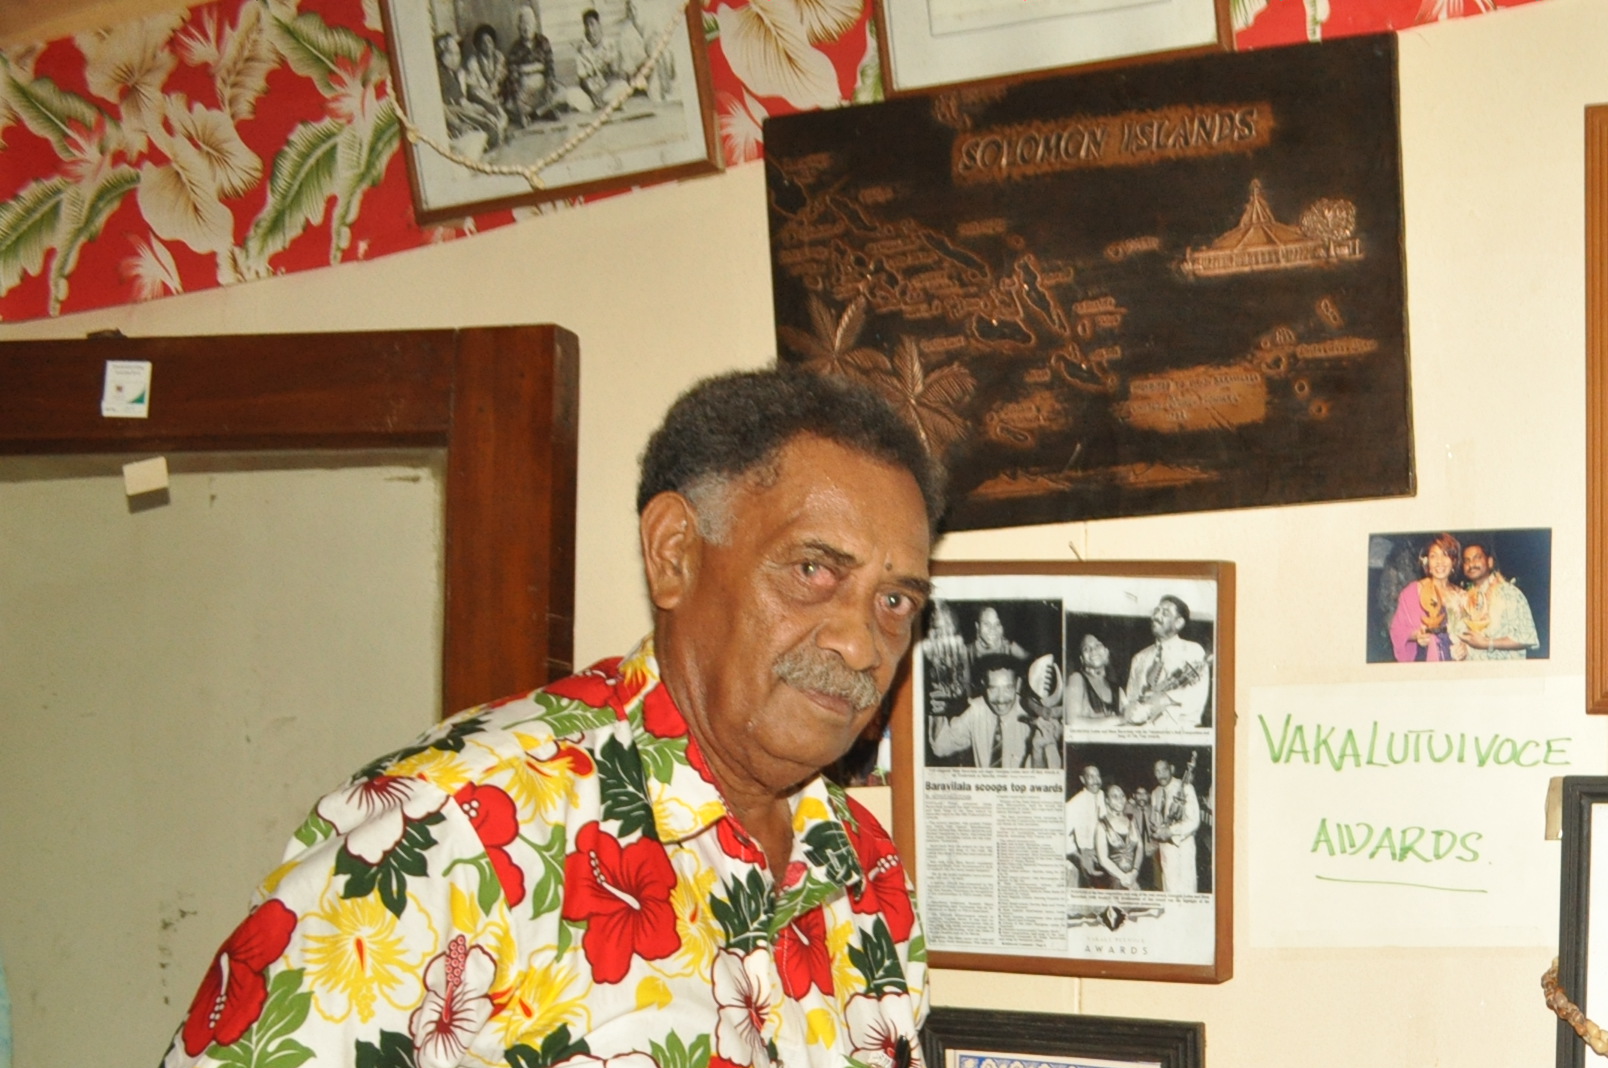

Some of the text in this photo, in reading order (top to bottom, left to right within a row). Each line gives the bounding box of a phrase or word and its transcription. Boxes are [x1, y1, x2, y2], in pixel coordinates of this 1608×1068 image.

[958, 107, 1259, 173] SOLOMON ISLANDS
[925, 781, 1063, 793] Baravilala scoops top awards
[1084, 945, 1149, 956] AWARDS
